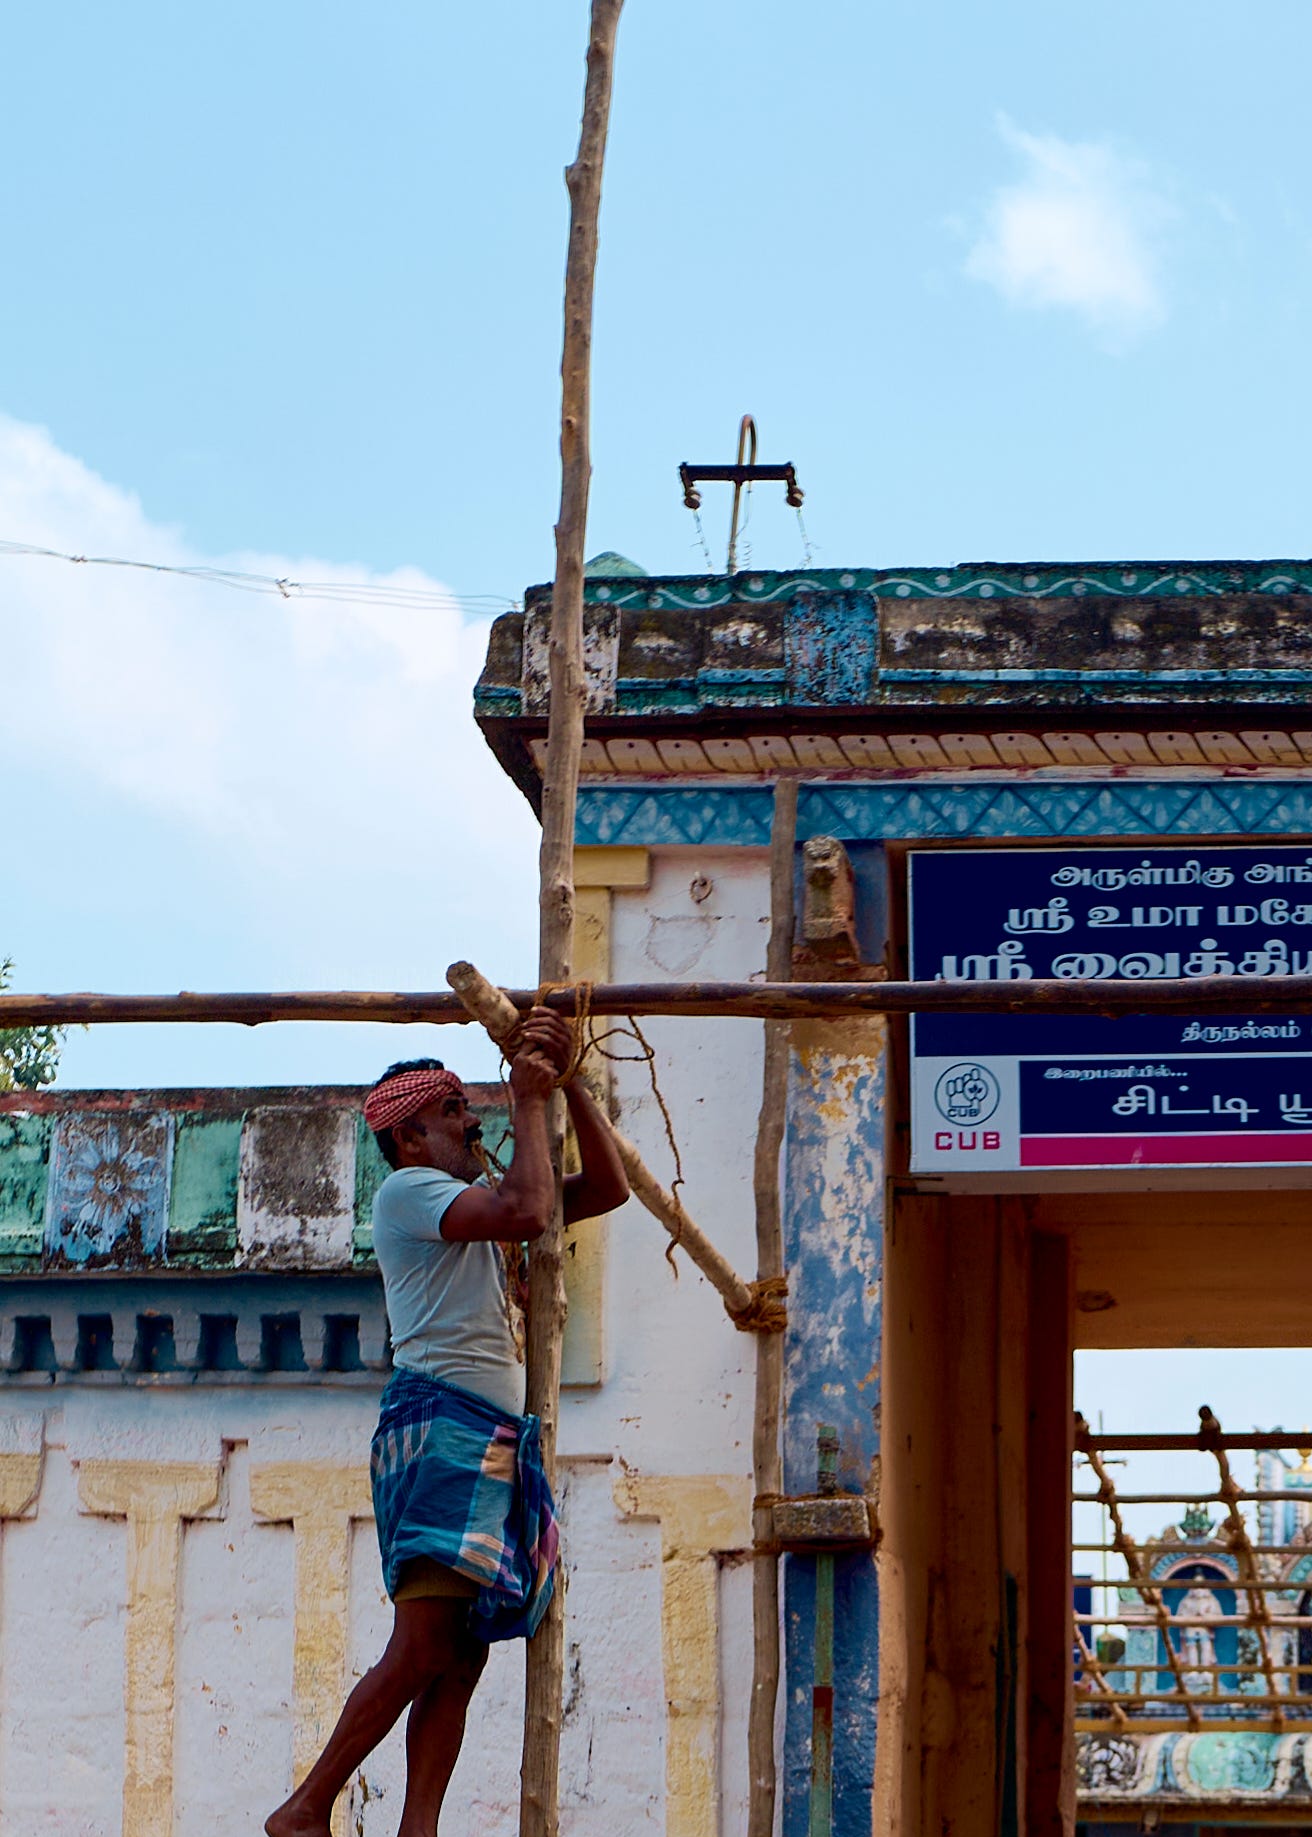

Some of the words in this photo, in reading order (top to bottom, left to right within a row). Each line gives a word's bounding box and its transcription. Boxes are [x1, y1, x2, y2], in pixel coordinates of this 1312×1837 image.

[1050, 859, 1235, 891] அருள்மிகு
[1087, 905, 1204, 928] உமா
[1180, 1019, 1301, 1043] திருநல்லம்
[947, 1107, 980, 1118] CUB
[1111, 1084, 1259, 1123] சிட்டி
[935, 1131, 1001, 1151] CUB
